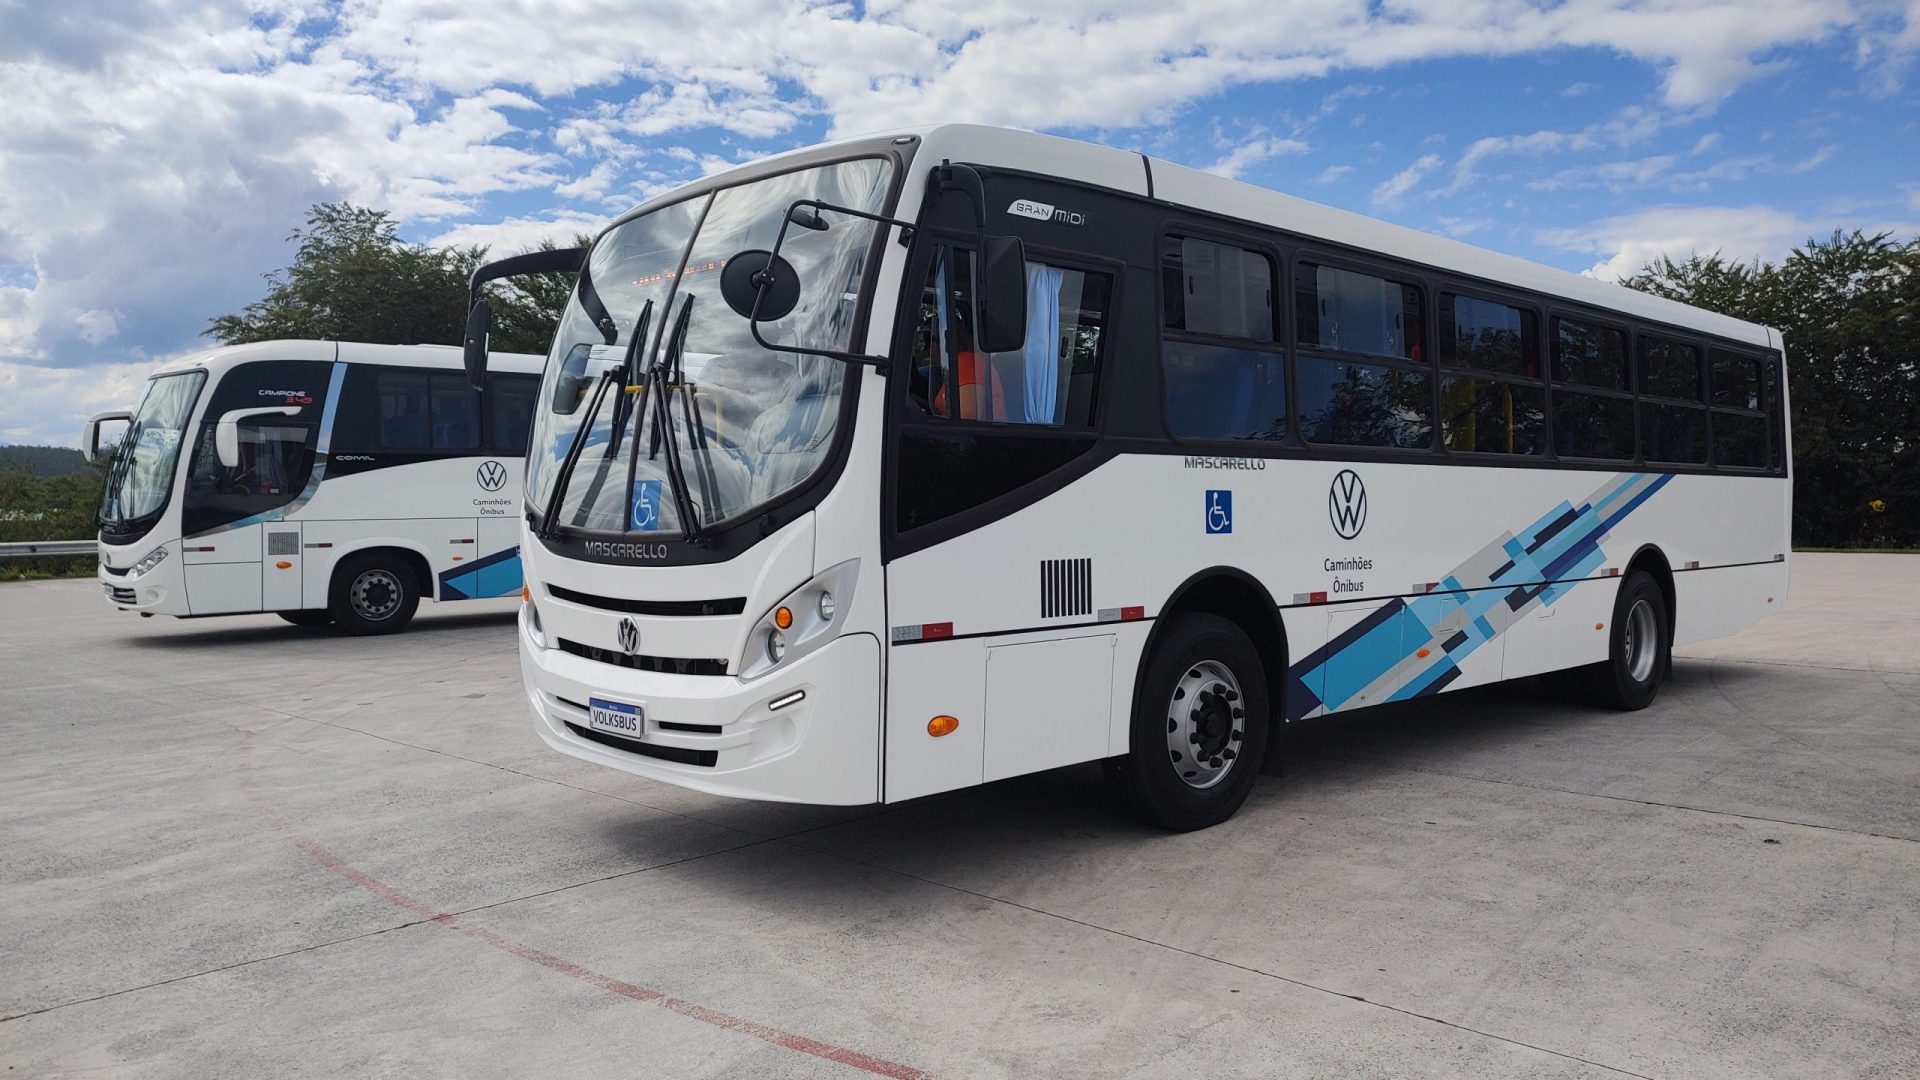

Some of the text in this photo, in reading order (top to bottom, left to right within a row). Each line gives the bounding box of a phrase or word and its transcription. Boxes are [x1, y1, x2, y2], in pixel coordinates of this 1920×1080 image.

[1016, 203, 1050, 217] GRAN
[258, 389, 306, 397] CAMPIONE
[1184, 456, 1266, 471] MASCARELLO
[472, 498, 512, 506] Caminhões
[480, 507, 505, 515] Ônibus
[585, 541, 668, 559] MASCARELLO
[1324, 557, 1373, 572] Caminhões
[1333, 576, 1364, 593] Ônibus
[593, 709, 637, 732] VOLKSBUS
